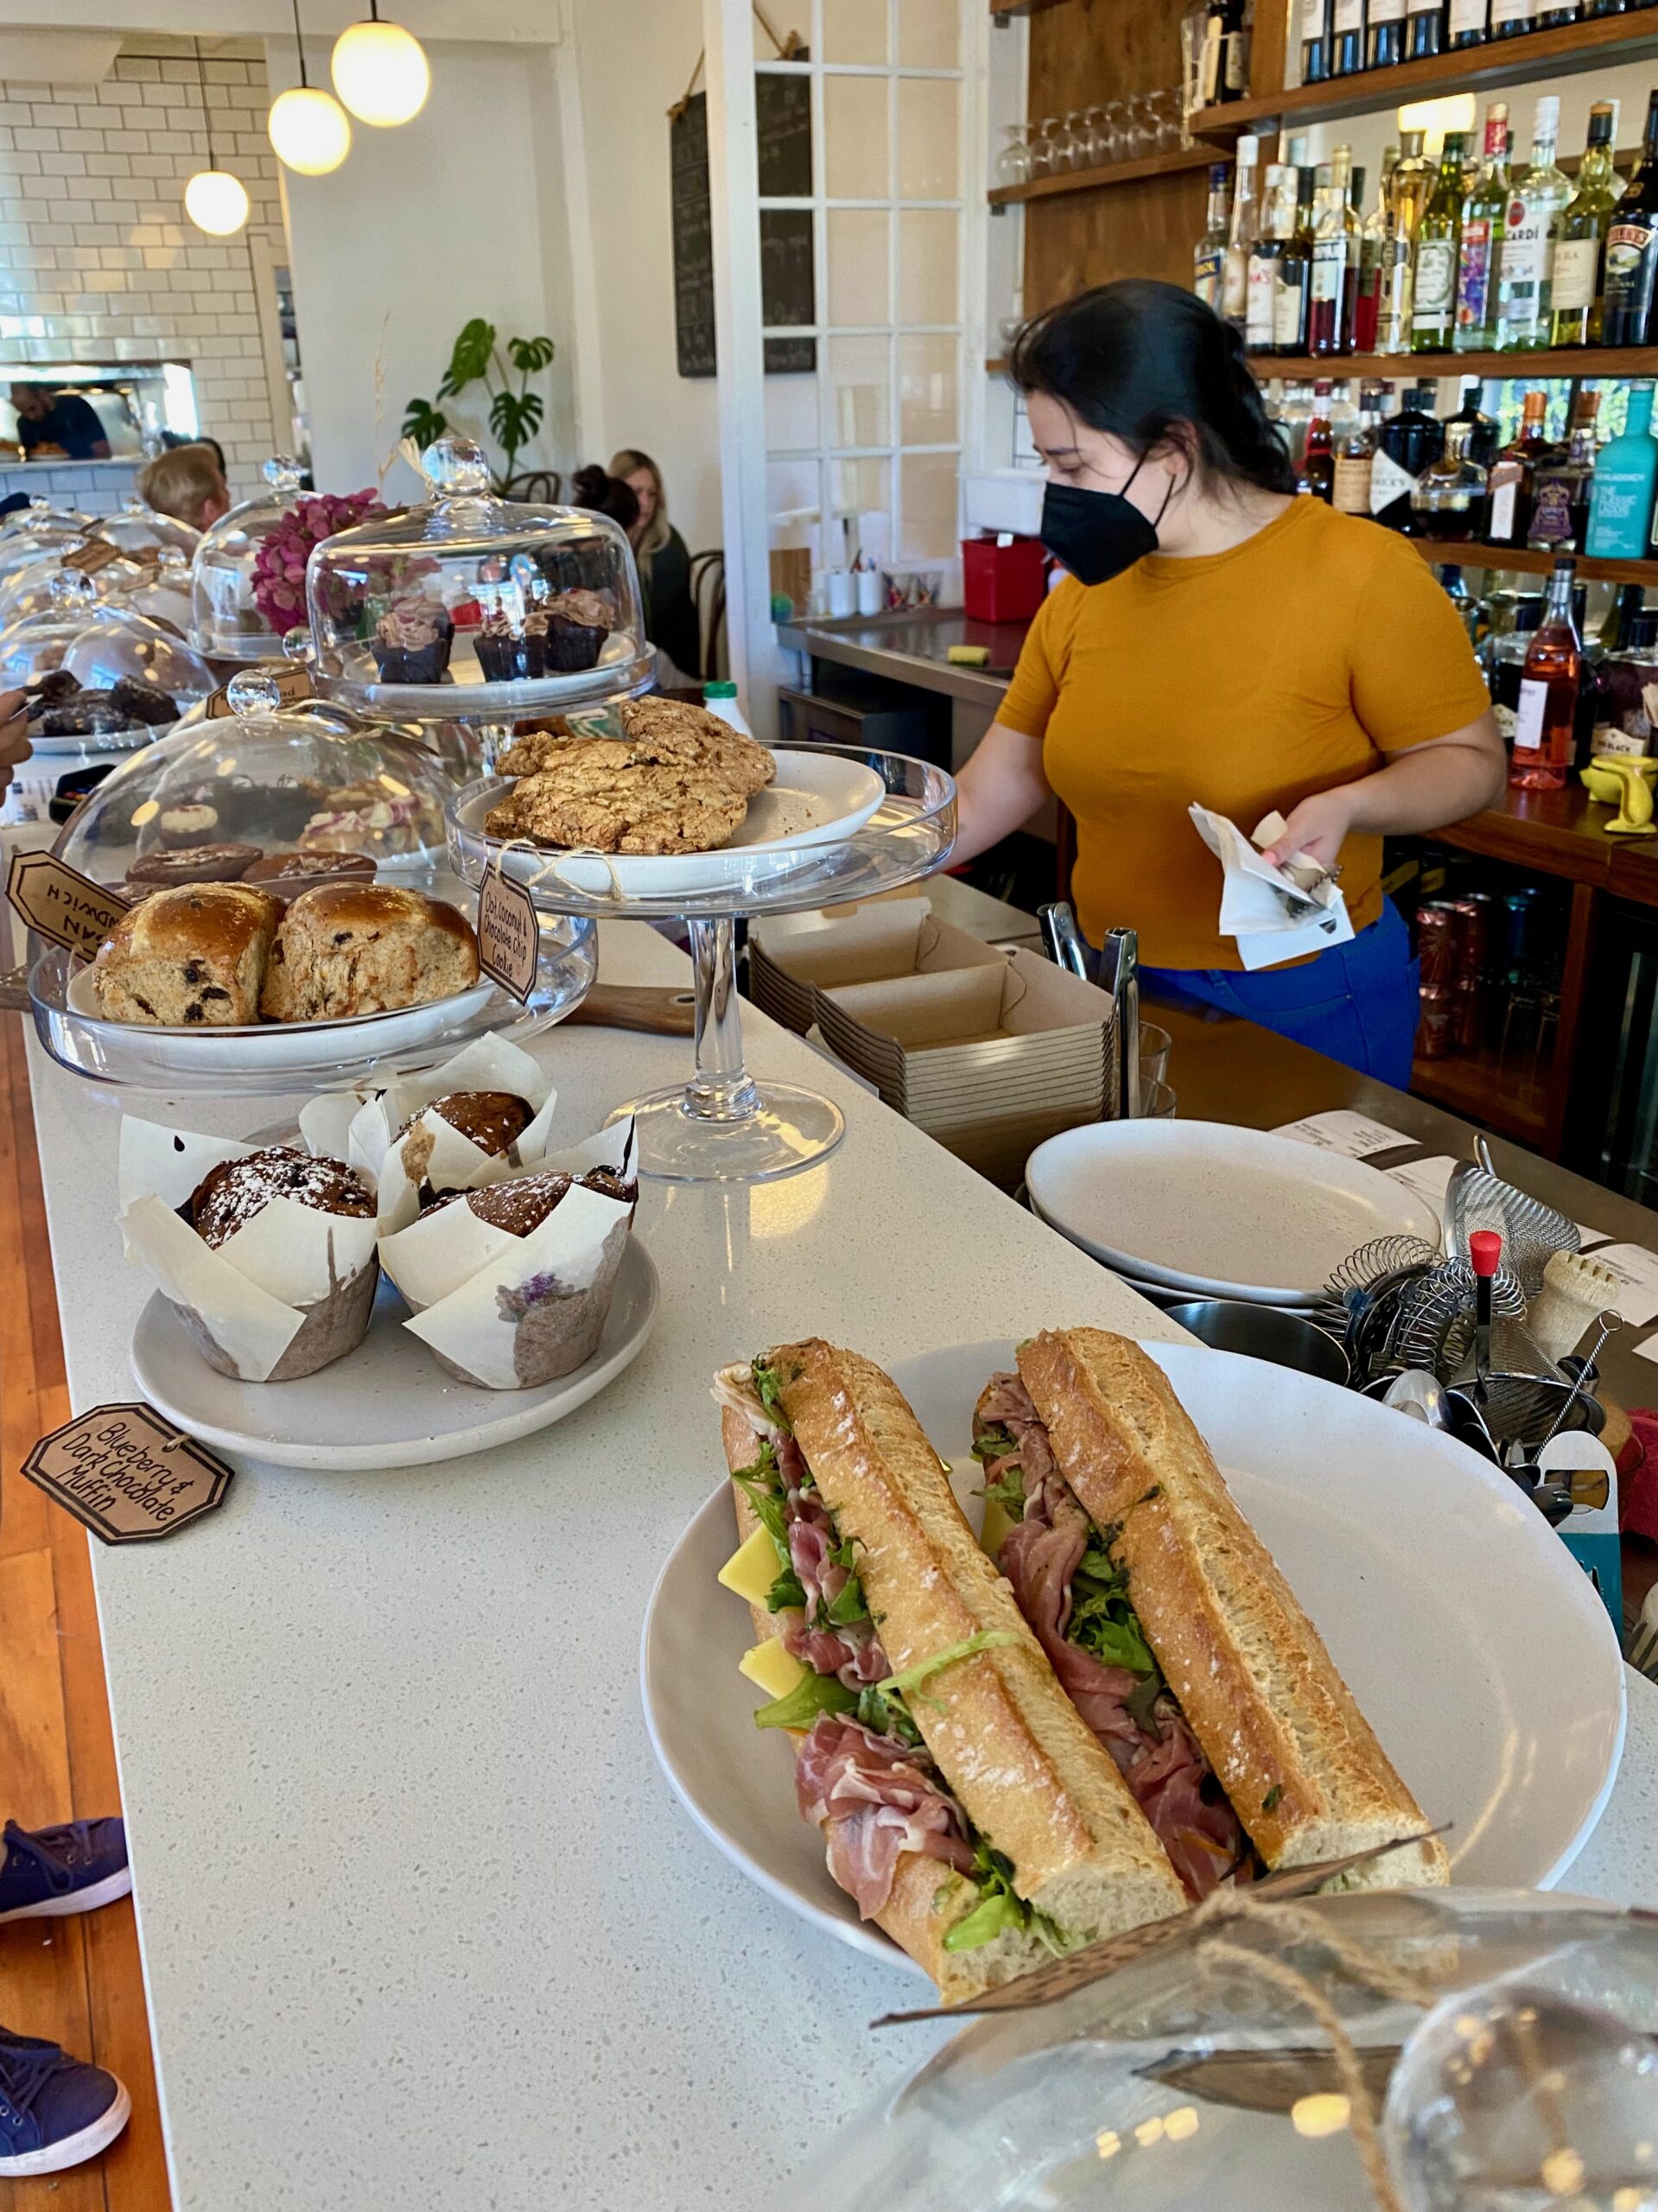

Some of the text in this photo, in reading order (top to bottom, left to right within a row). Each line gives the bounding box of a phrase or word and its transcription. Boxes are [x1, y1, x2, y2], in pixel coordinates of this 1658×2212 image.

[1505, 226, 1539, 241] CARDÍ
[484, 914, 511, 950] Chocolate
[499, 900, 522, 934] Coconut
[492, 944, 513, 978] Cookie
[97, 1421, 177, 1488] Blueberry
[55, 1464, 117, 1512] Muffin
[62, 1433, 175, 1522] Dark Chocolate
